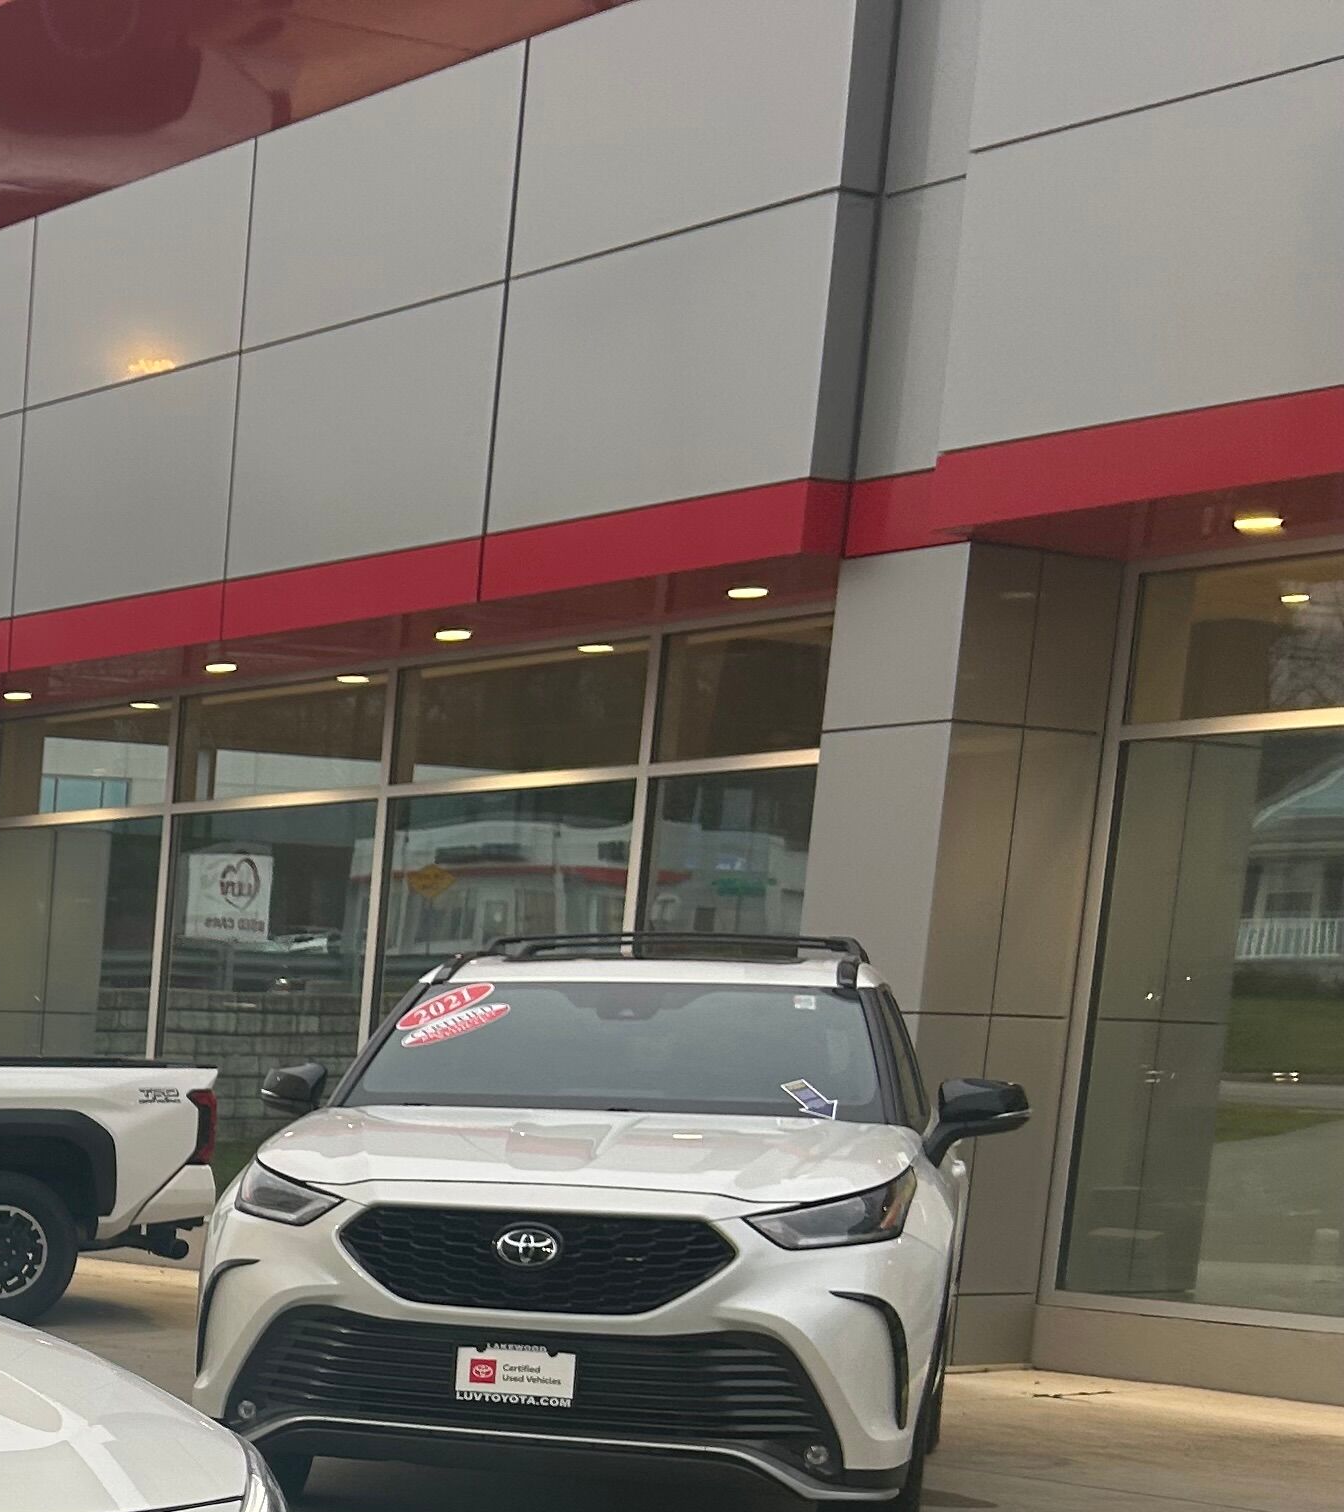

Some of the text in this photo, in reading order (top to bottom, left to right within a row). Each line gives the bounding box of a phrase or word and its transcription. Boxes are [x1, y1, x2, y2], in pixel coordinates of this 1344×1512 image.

[413, 987, 473, 1026] 2021
[502, 1363, 541, 1374] Certified
[502, 1374, 562, 1386] Used Vehicles
[456, 1390, 572, 1408] LUVTOYOTA.COM
